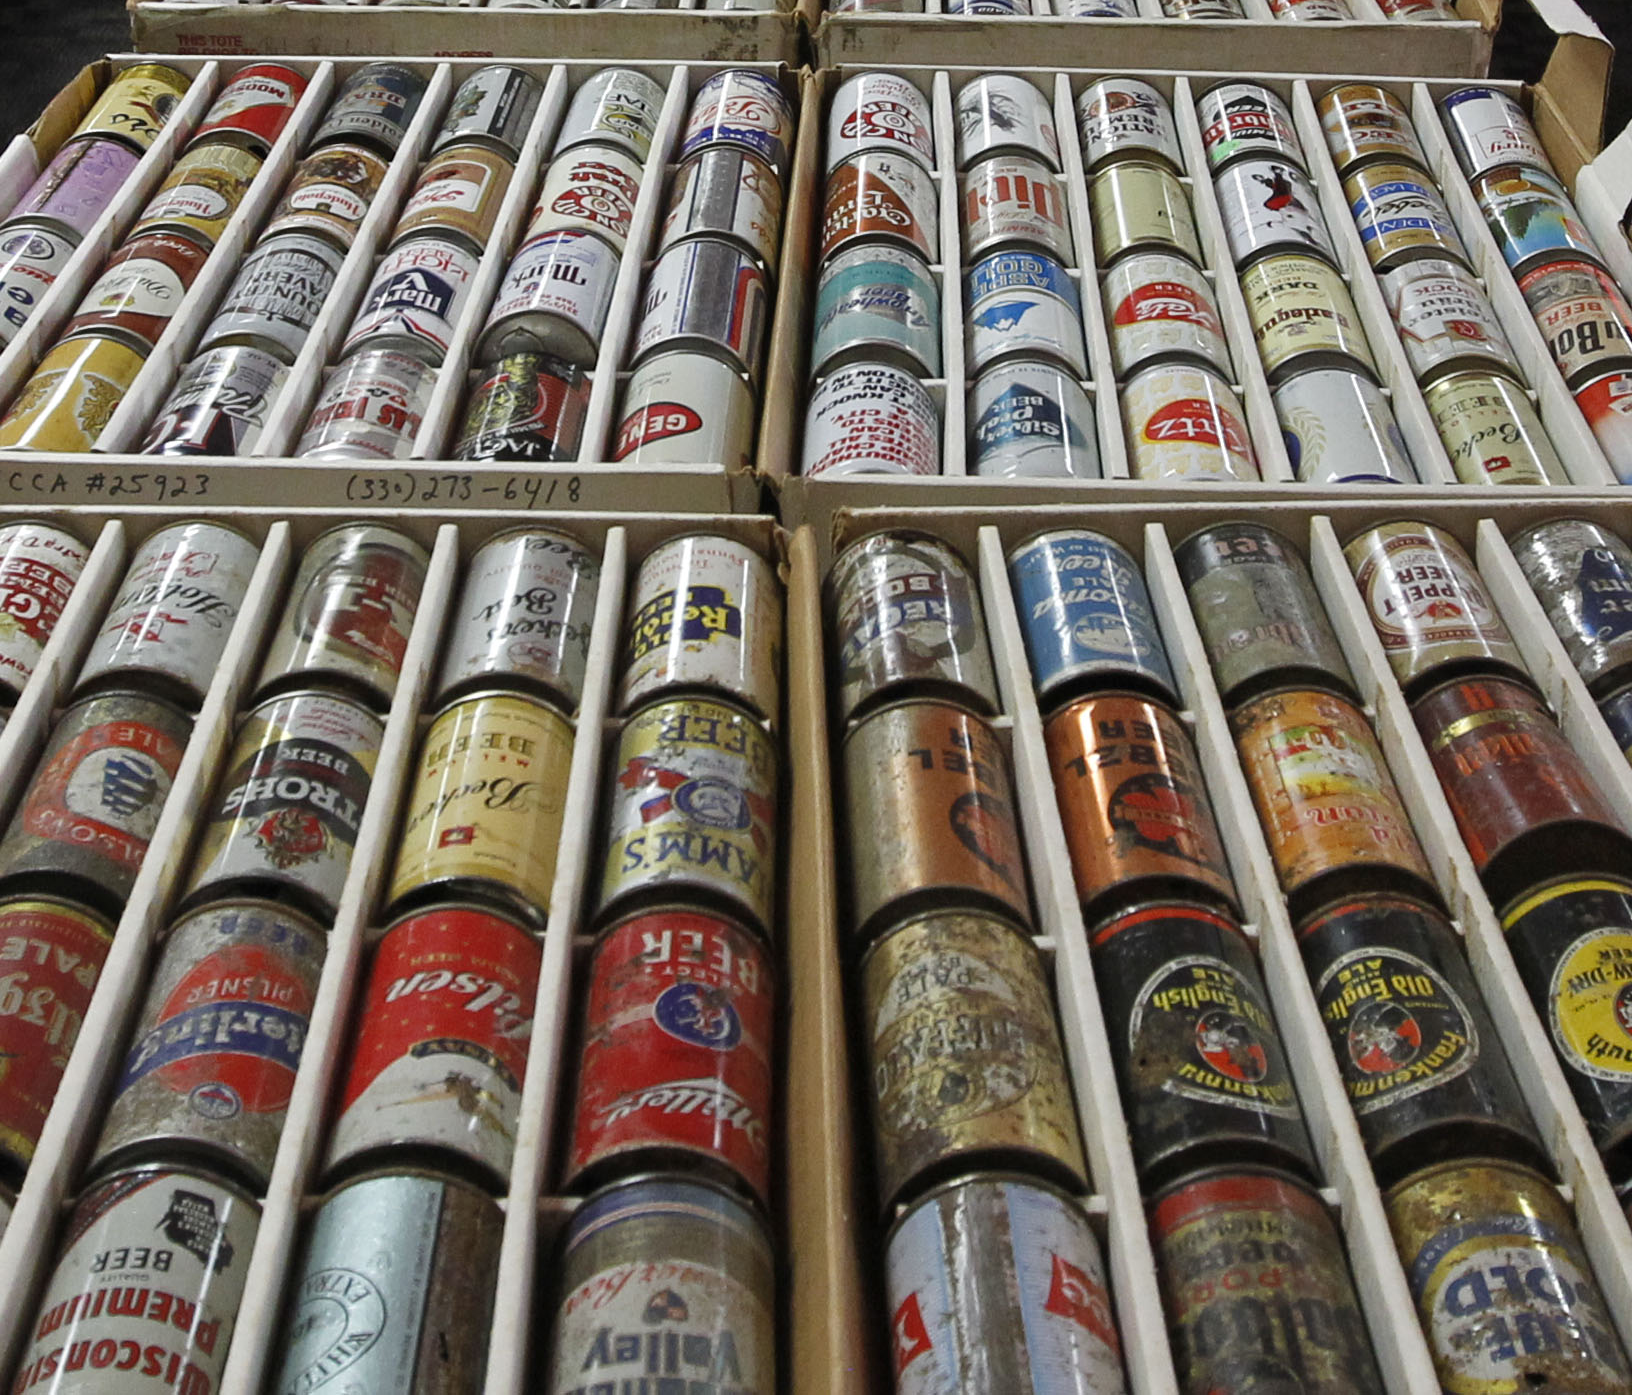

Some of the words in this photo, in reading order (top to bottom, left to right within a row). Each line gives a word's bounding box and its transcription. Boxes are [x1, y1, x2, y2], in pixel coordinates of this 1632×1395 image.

[177, 35, 207, 46] THIS
[209, 35, 242, 47] TOTE
[509, 262, 587, 292] Mark
[1545, 302, 1602, 327] BEER
[989, 395, 1044, 407] BEER
[840, 419, 864, 429] TO
[848, 426, 895, 435] CAN
[827, 434, 863, 449] ALL
[86, 472, 210, 500] #25923
[119, 727, 168, 754] ALE
[1337, 957, 1383, 983] ALE
[186, 975, 293, 1004] PILSNER
[1151, 978, 1238, 1012] English
[1392, 974, 1433, 998] Old
[129, 1010, 305, 1075] terling
[90, 1247, 173, 1273] BEER
[35, 1287, 218, 1356] PREMIUM
